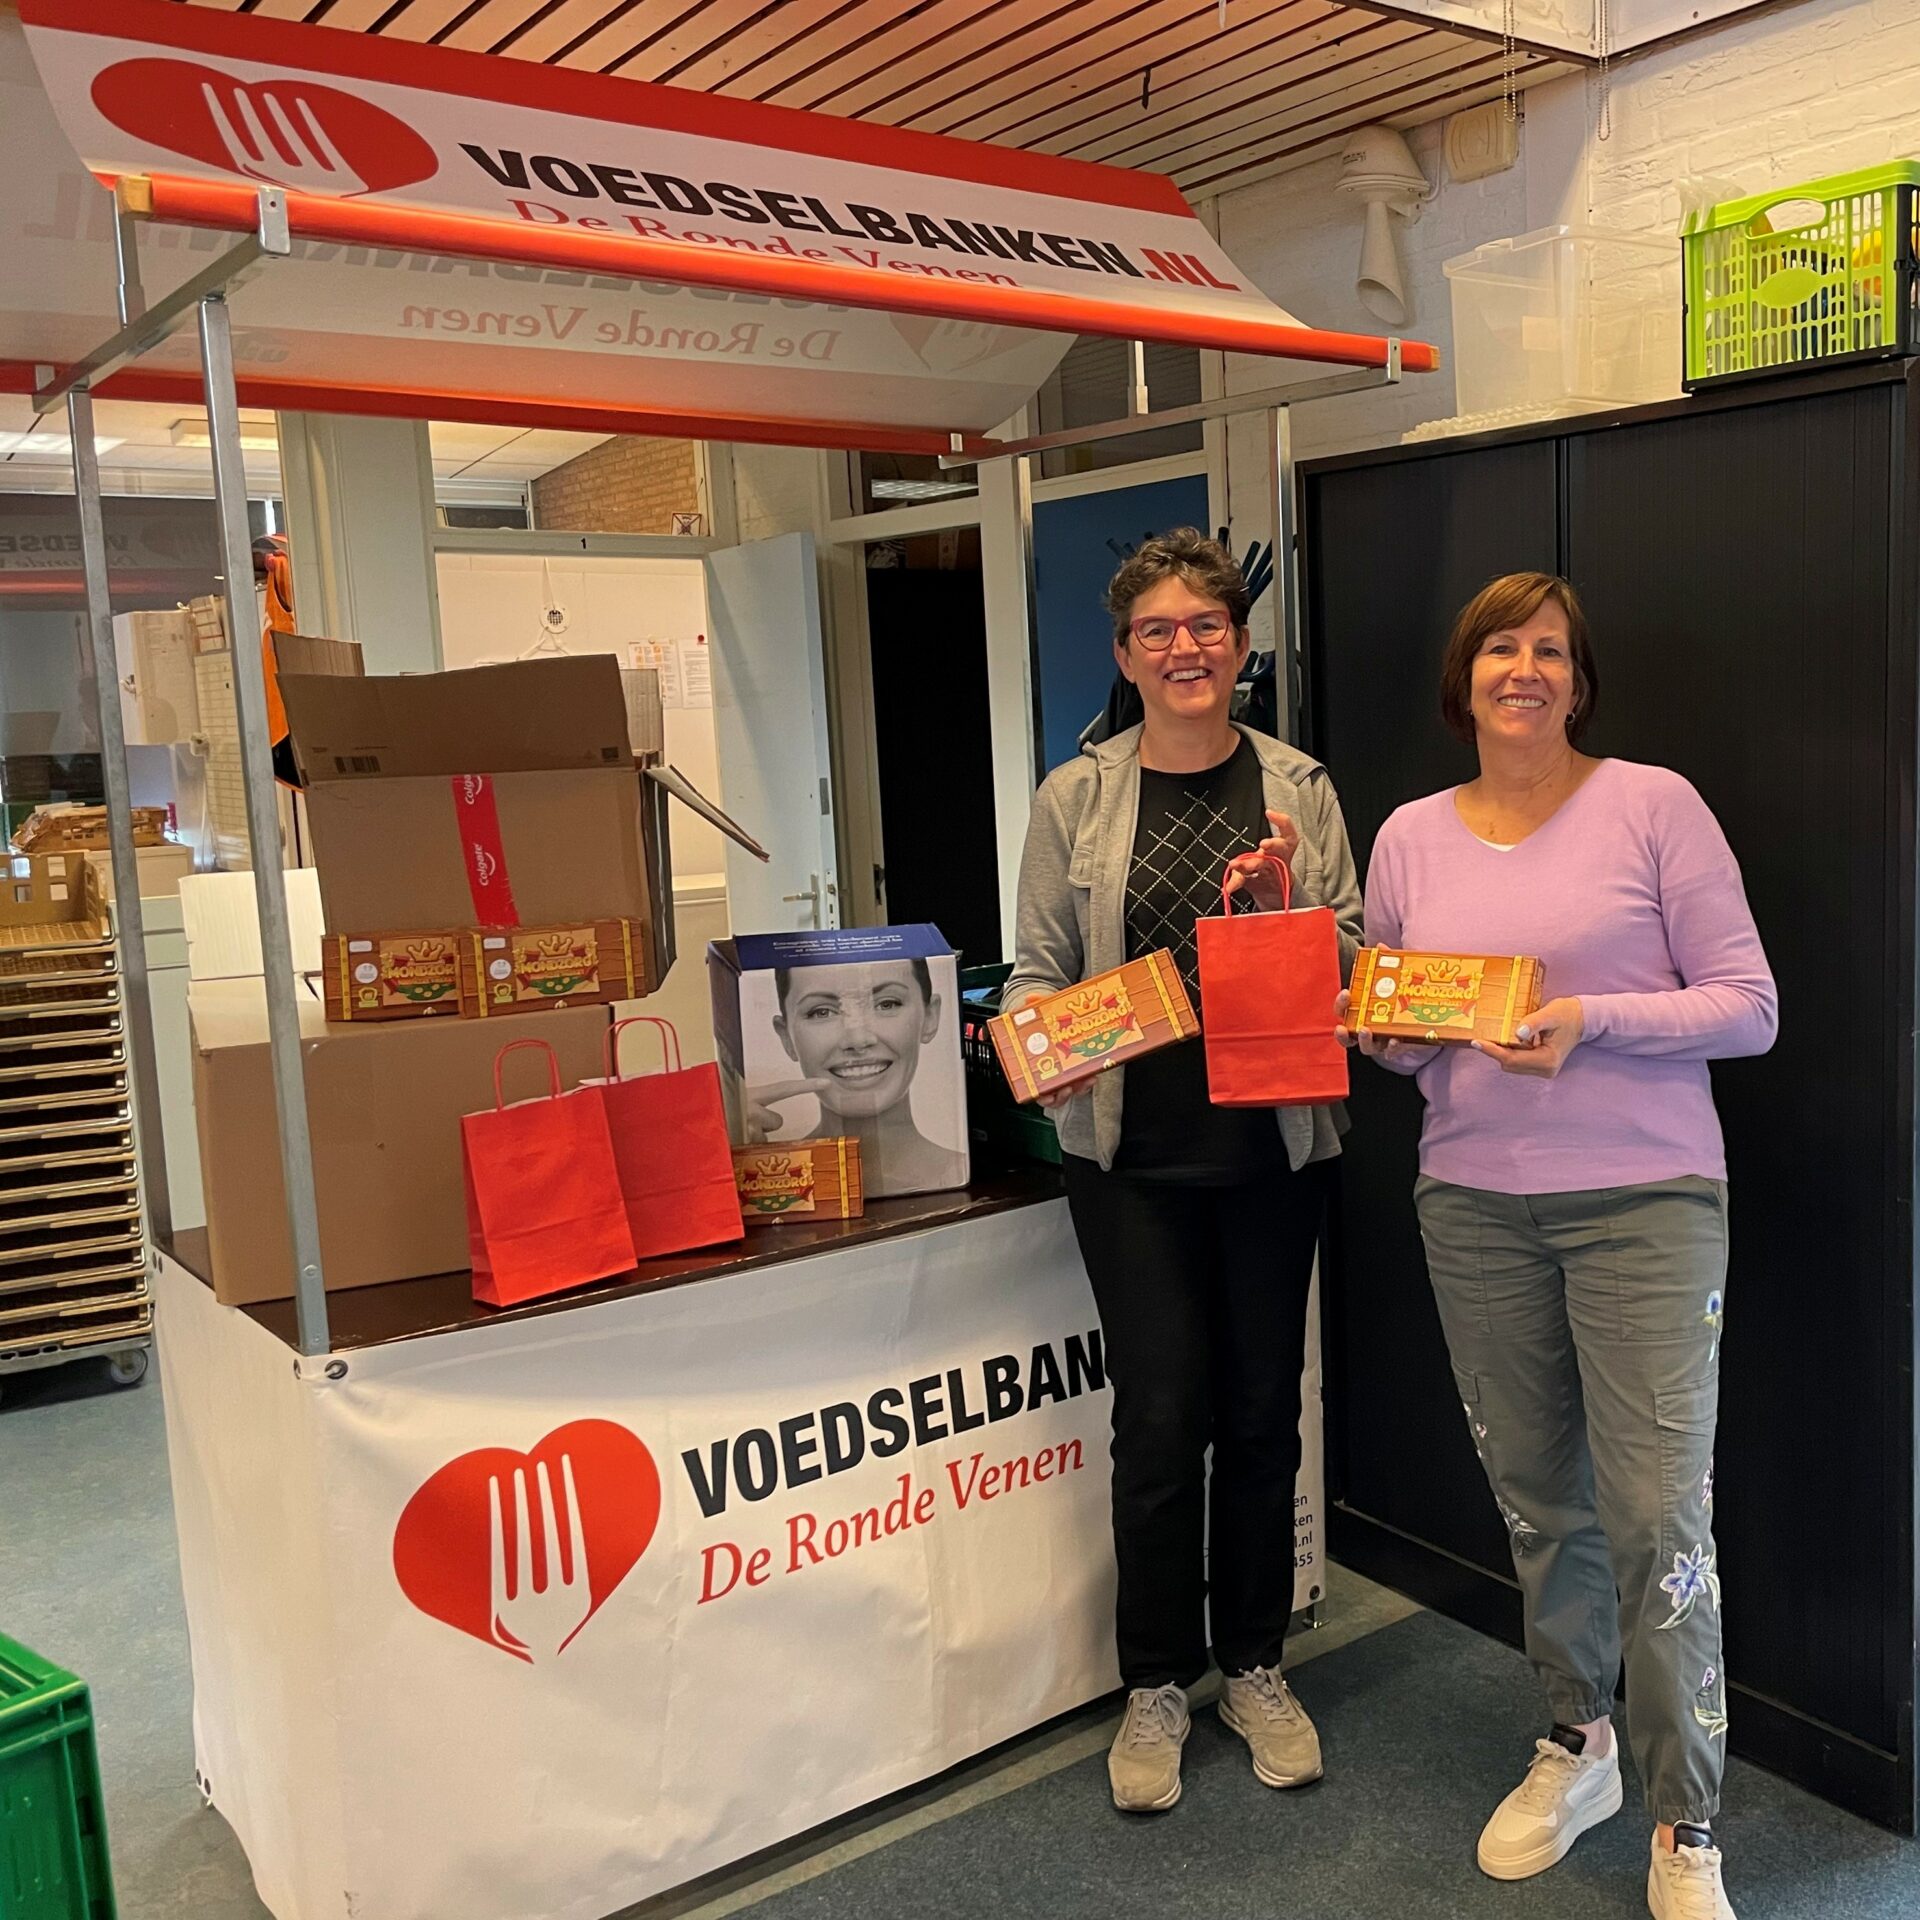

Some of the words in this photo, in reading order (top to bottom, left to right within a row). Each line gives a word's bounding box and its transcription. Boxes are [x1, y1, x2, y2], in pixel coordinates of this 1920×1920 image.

[458, 143, 1241, 291] VOEDSELBANKEN.NL
[506, 199, 613, 231] De
[621, 214, 834, 263] Ronde
[833, 246, 1023, 287] Venen
[581, 537, 587, 549] 1
[473, 842, 489, 886] Colgate
[697, 1542, 771, 1606] De
[786, 1473, 936, 1574] Ronde
[945, 1438, 1084, 1510] Venen
